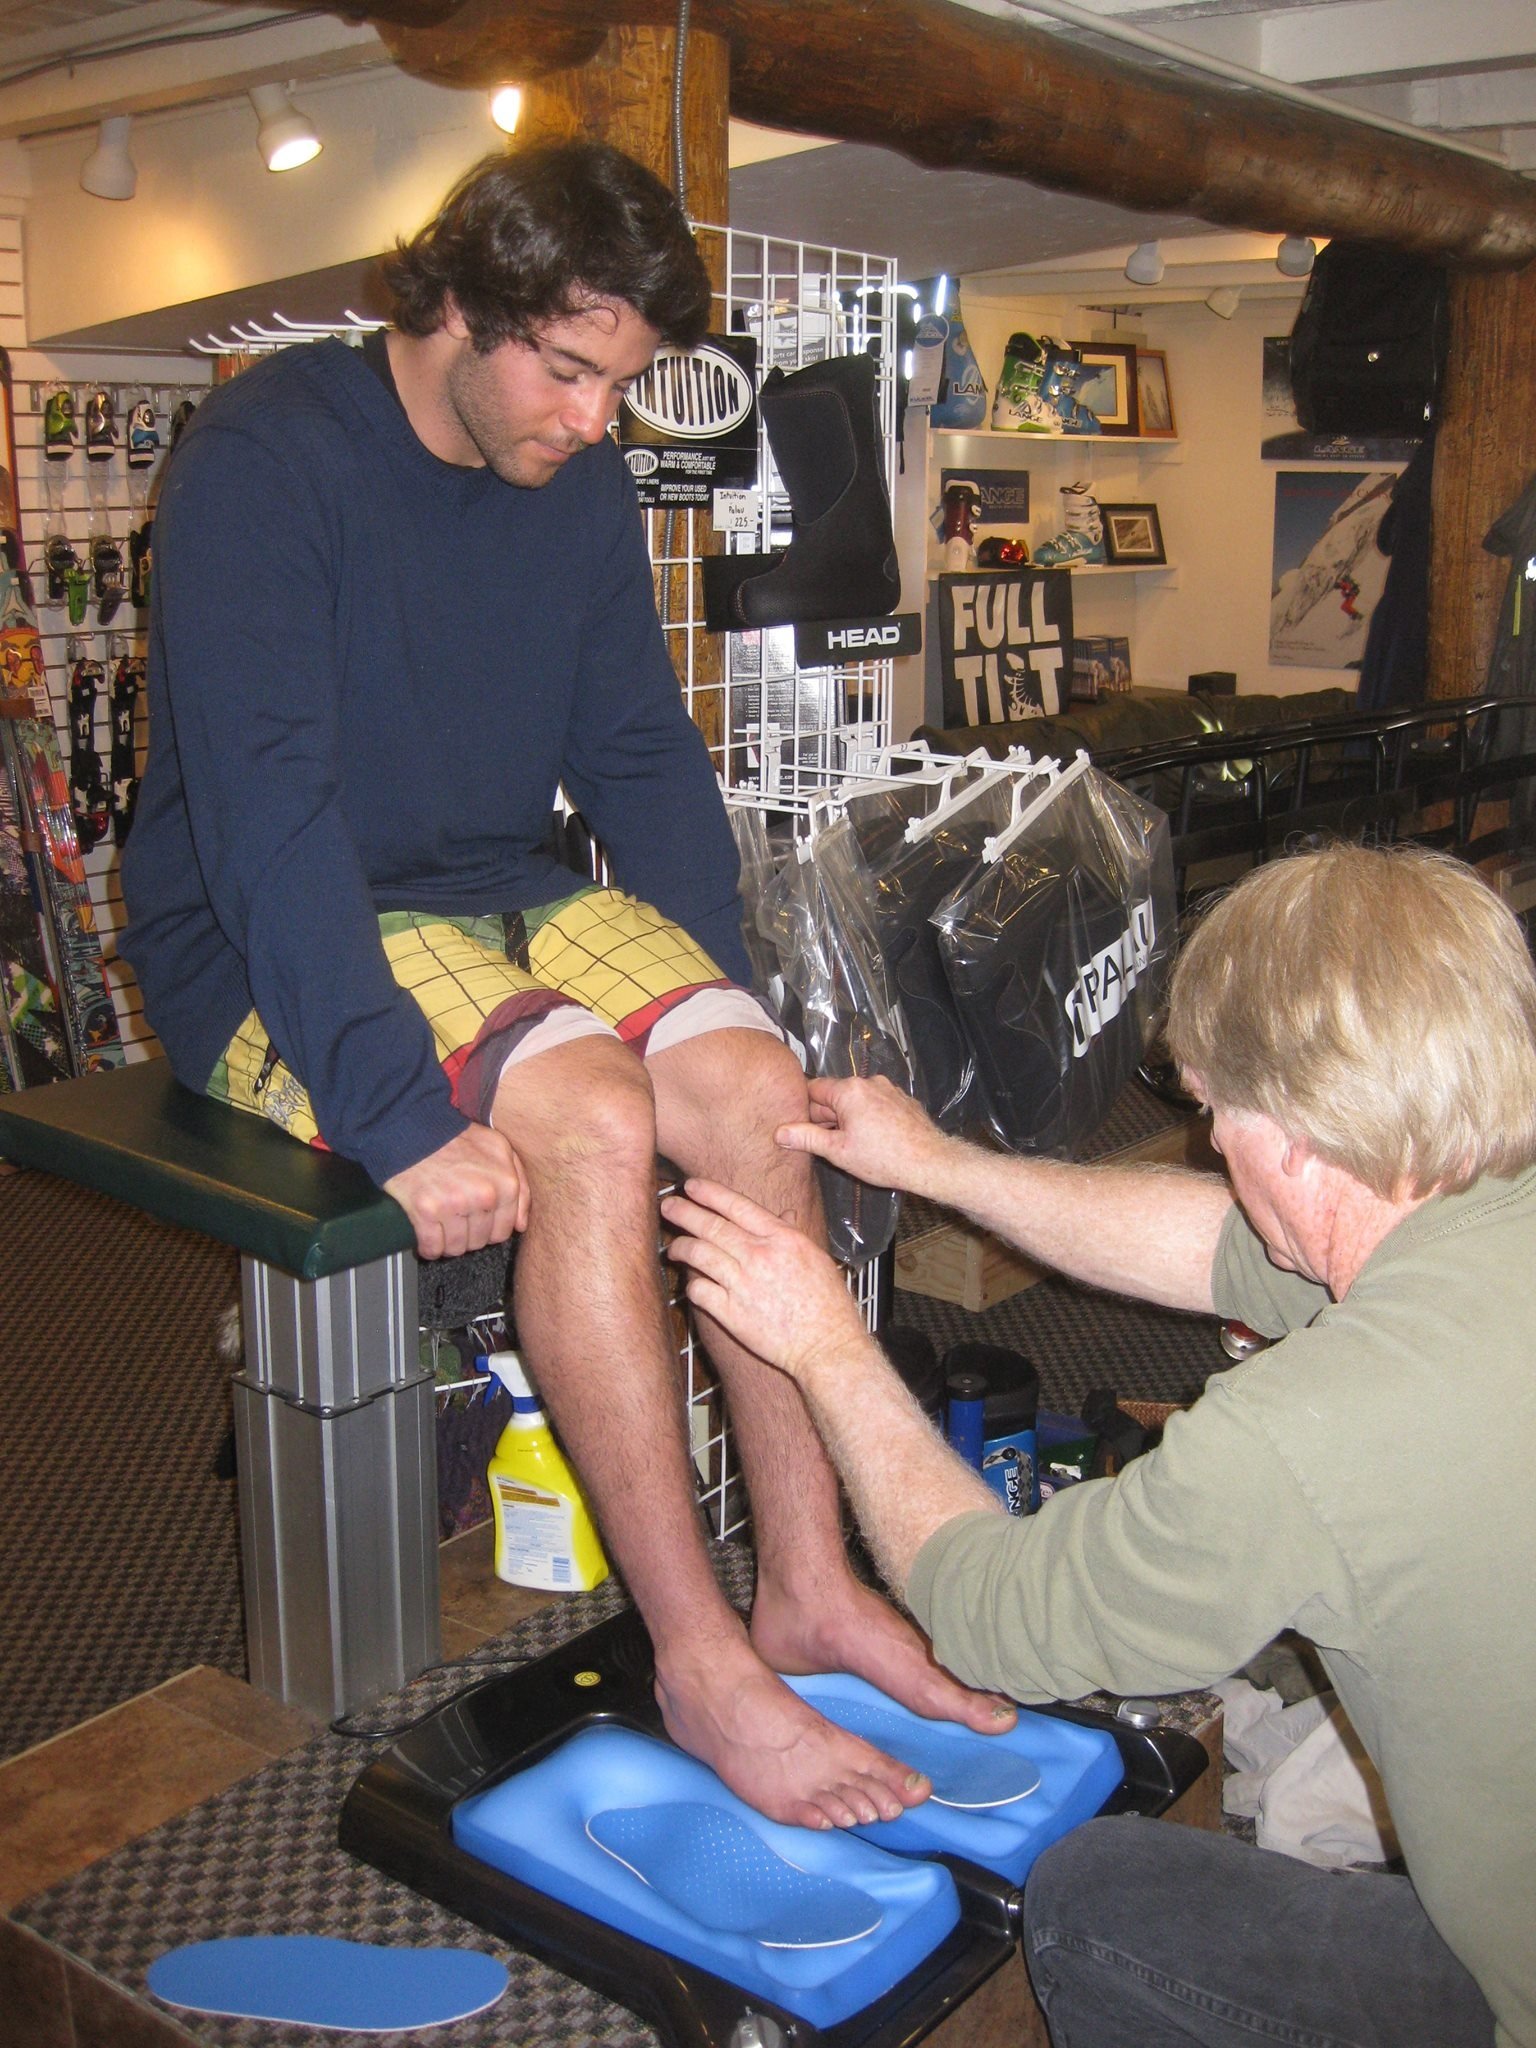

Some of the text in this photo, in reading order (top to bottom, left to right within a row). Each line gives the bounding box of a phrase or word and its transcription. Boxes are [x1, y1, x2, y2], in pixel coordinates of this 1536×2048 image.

[663, 451, 703, 461] PERFORMANCE
[660, 460, 676, 469] WARM
[681, 461, 717, 471] COMFORTABLE
[660, 484, 708, 494] IMPROVE YOUR USED
[719, 491, 747, 500] Intuition
[980, 487, 1025, 505] ANGE
[951, 581, 1061, 651] FULL
[827, 626, 900, 650] HEAD
